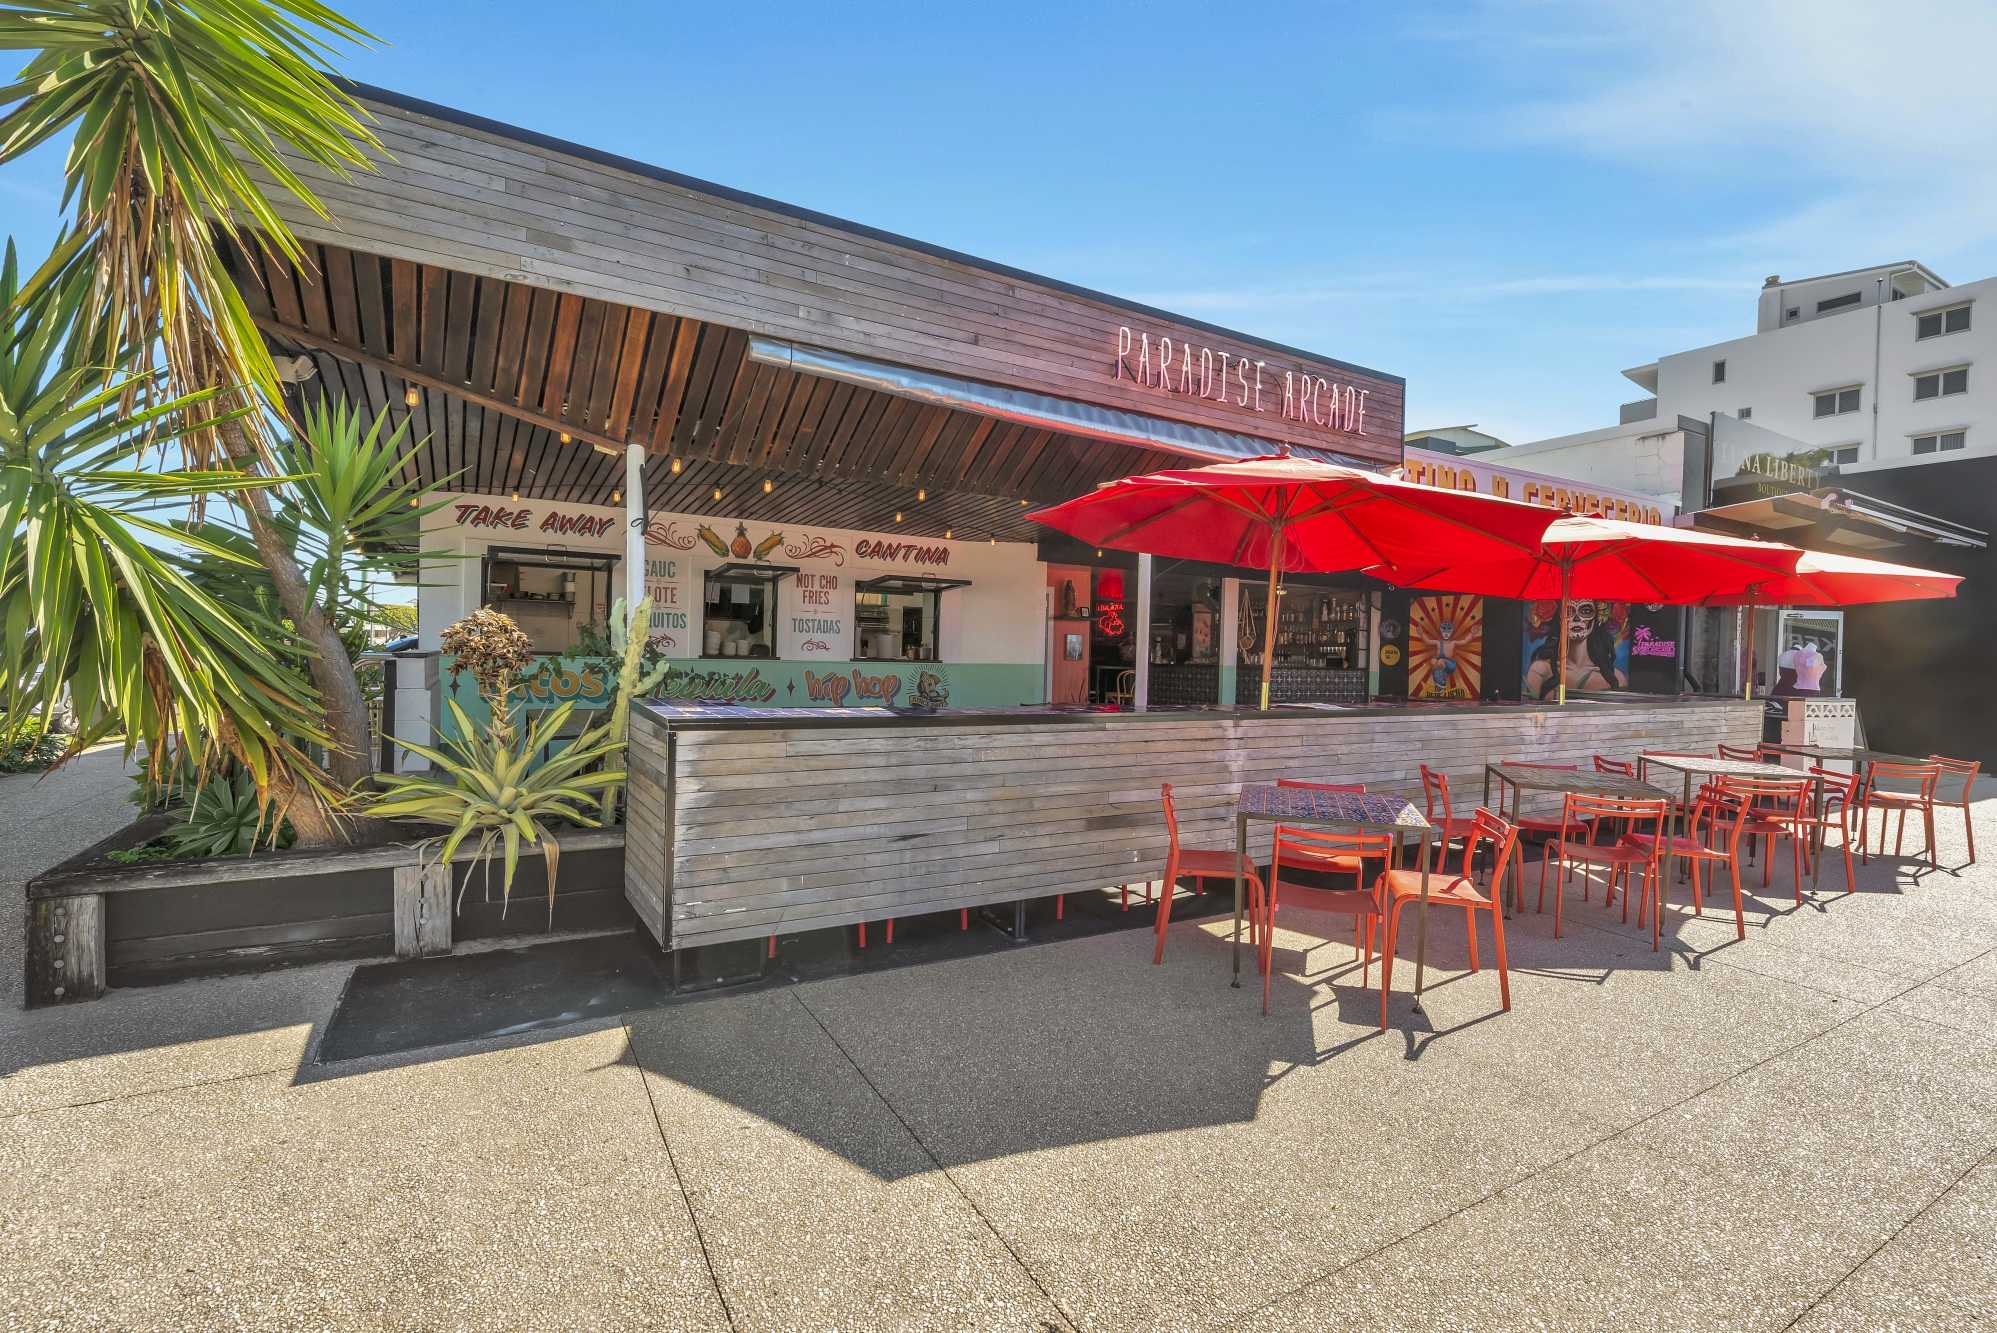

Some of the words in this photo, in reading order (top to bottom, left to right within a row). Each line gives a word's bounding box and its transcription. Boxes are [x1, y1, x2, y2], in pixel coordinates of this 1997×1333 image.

[1115, 326, 1266, 412] PARADISE
[1281, 371, 1370, 436] ARCADE
[1721, 441, 1761, 474] LUNA
[1766, 456, 1822, 490] LIBERTY
[455, 504, 533, 530] TAKE
[539, 511, 615, 538] AWAY
[855, 539, 950, 565] CANTINA
[796, 573, 816, 588] NOT
[819, 575, 838, 590] CHO
[645, 586, 677, 604] LOTE
[802, 589, 830, 605] FRIES
[792, 618, 841, 634] TOSTADAS
[852, 668, 901, 705] hop
